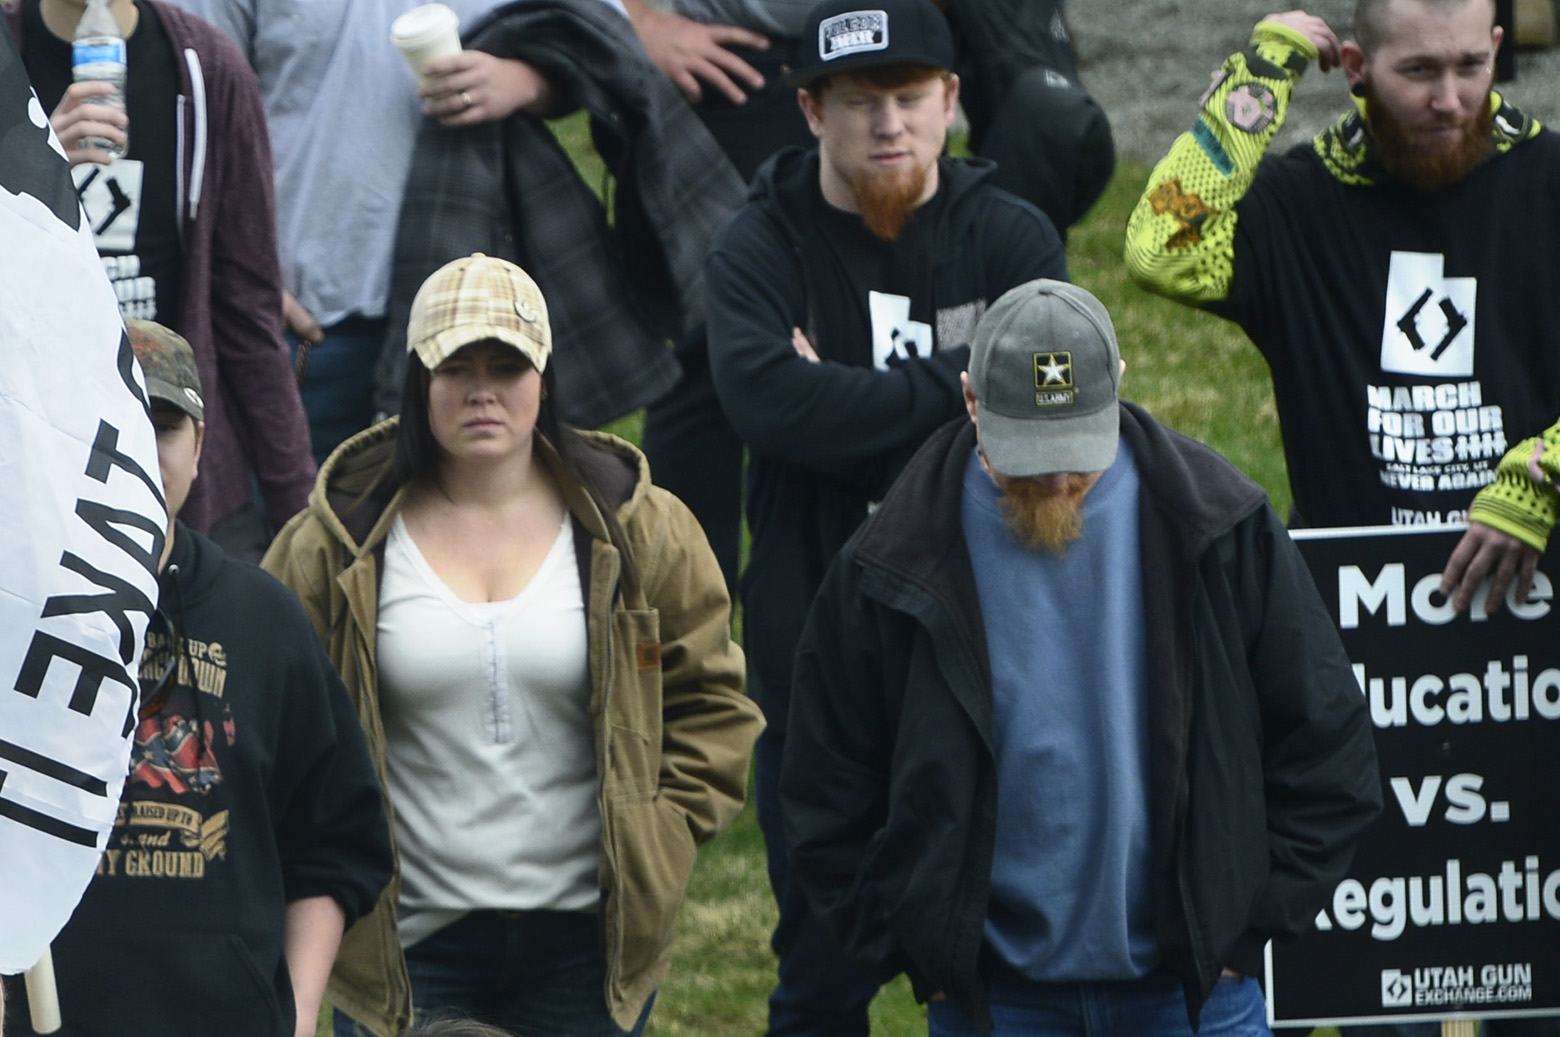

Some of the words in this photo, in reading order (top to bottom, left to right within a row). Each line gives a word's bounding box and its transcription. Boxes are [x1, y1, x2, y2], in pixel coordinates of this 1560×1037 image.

[1367, 381, 1482, 412] MARCH
[1368, 407, 1425, 438] FOR
[1431, 405, 1504, 437] OUR
[1369, 434, 1456, 465] LIVES
[1438, 468, 1498, 492] AGAIN
[1391, 505, 1441, 526] UTAH
[15, 417, 168, 739] TAKE
[188, 639, 208, 659] UP
[1351, 655, 1560, 728] ucatio
[1390, 773, 1510, 826] vs.
[125, 849, 206, 878] GROUND
[1414, 965, 1474, 988] UTAH
[1481, 962, 1532, 988] GUN
[1414, 984, 1533, 1007] EXCHANGE.COM
